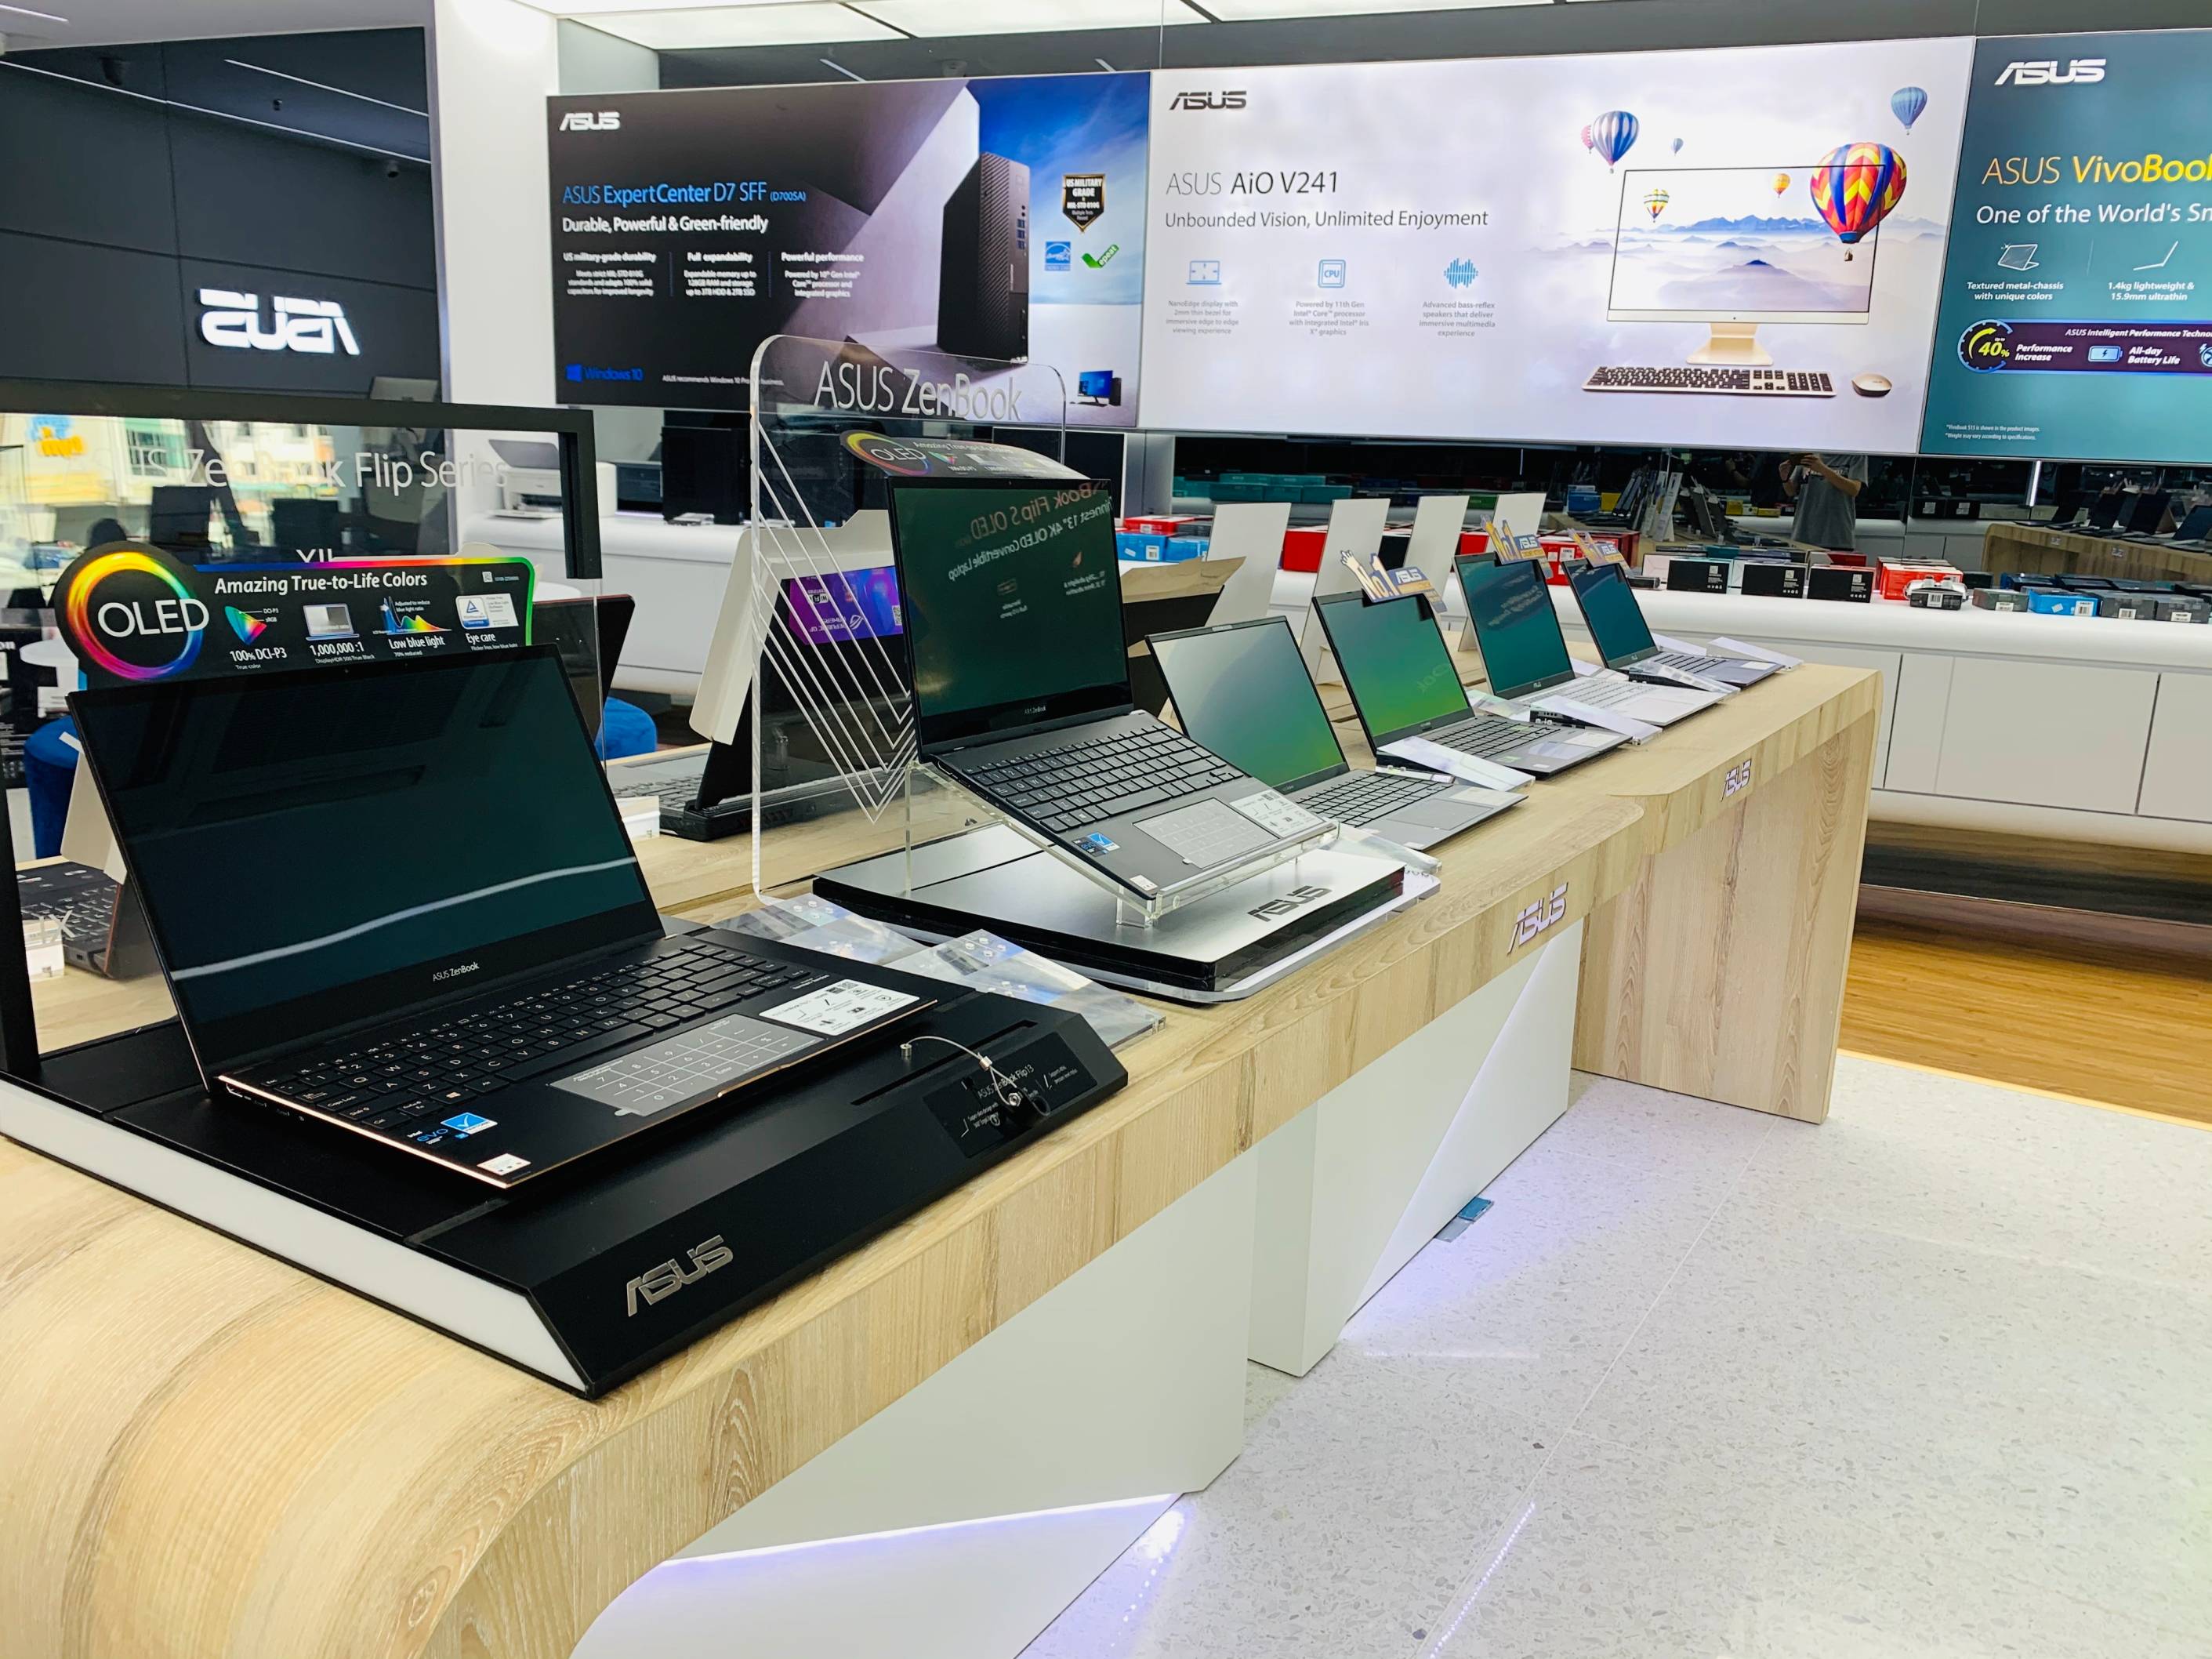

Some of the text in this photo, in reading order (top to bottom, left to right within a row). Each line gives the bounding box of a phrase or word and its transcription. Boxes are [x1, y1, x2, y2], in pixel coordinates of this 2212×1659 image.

[1995, 59, 2106, 85] ASUS
[1169, 91, 1246, 110] ASUS
[560, 112, 620, 131] ASUS
[1982, 157, 2061, 185] ASUS
[1166, 172, 1337, 195] ASUS AiO V241
[563, 185, 600, 205] ASUS
[604, 184, 711, 207] ExpertCenter
[714, 183, 734, 201] D7
[739, 182, 767, 201] SFF
[1166, 210, 1489, 230] Unbounded Vision, Unlimited Enjoyment
[1976, 205, 2021, 224] One
[2027, 205, 2051, 223] of
[2055, 205, 2091, 223] the
[2098, 204, 2181, 223] World's
[563, 215, 768, 234] Durable, Powerful & Green-friendly
[687, 252, 753, 263] Full expandability
[781, 252, 865, 263] Powerful performance
[1099, 246, 1116, 265] epeat
[1324, 270, 1340, 278] CPU
[1967, 281, 2064, 290] Textured metal-chassis
[2108, 281, 2131, 292] 1.4kg
[2134, 281, 2185, 292] lightweight
[1172, 327, 1195, 336] viewing
[2087, 329, 2129, 338] Intelligent
[2016, 344, 2072, 353] Performance
[2129, 347, 2162, 357] All-day
[2128, 356, 2160, 365] Battery
[585, 368, 629, 380] Windows
[814, 361, 1021, 421] ASUS ZenBook
[870, 448, 927, 461] OLED
[354, 452, 412, 496] Flip
[420, 451, 507, 488] Series
[215, 572, 427, 595] Amazing True-to-Life Colors
[1395, 568, 1422, 583] ASUS
[98, 598, 209, 637] OLED
[389, 635, 445, 649] Low blue light
[466, 633, 496, 644] Eye care
[230, 648, 287, 662] 100% DCI-P3
[310, 643, 355, 655] 1,000,000
[1721, 760, 1752, 801] ASUS
[1248, 885, 1331, 922] ASUS
[1507, 882, 1568, 954] ASUS
[433, 961, 480, 982] ASUS ZenBook
[417, 1128, 448, 1142] evo
[627, 1235, 734, 1316] ASUS
